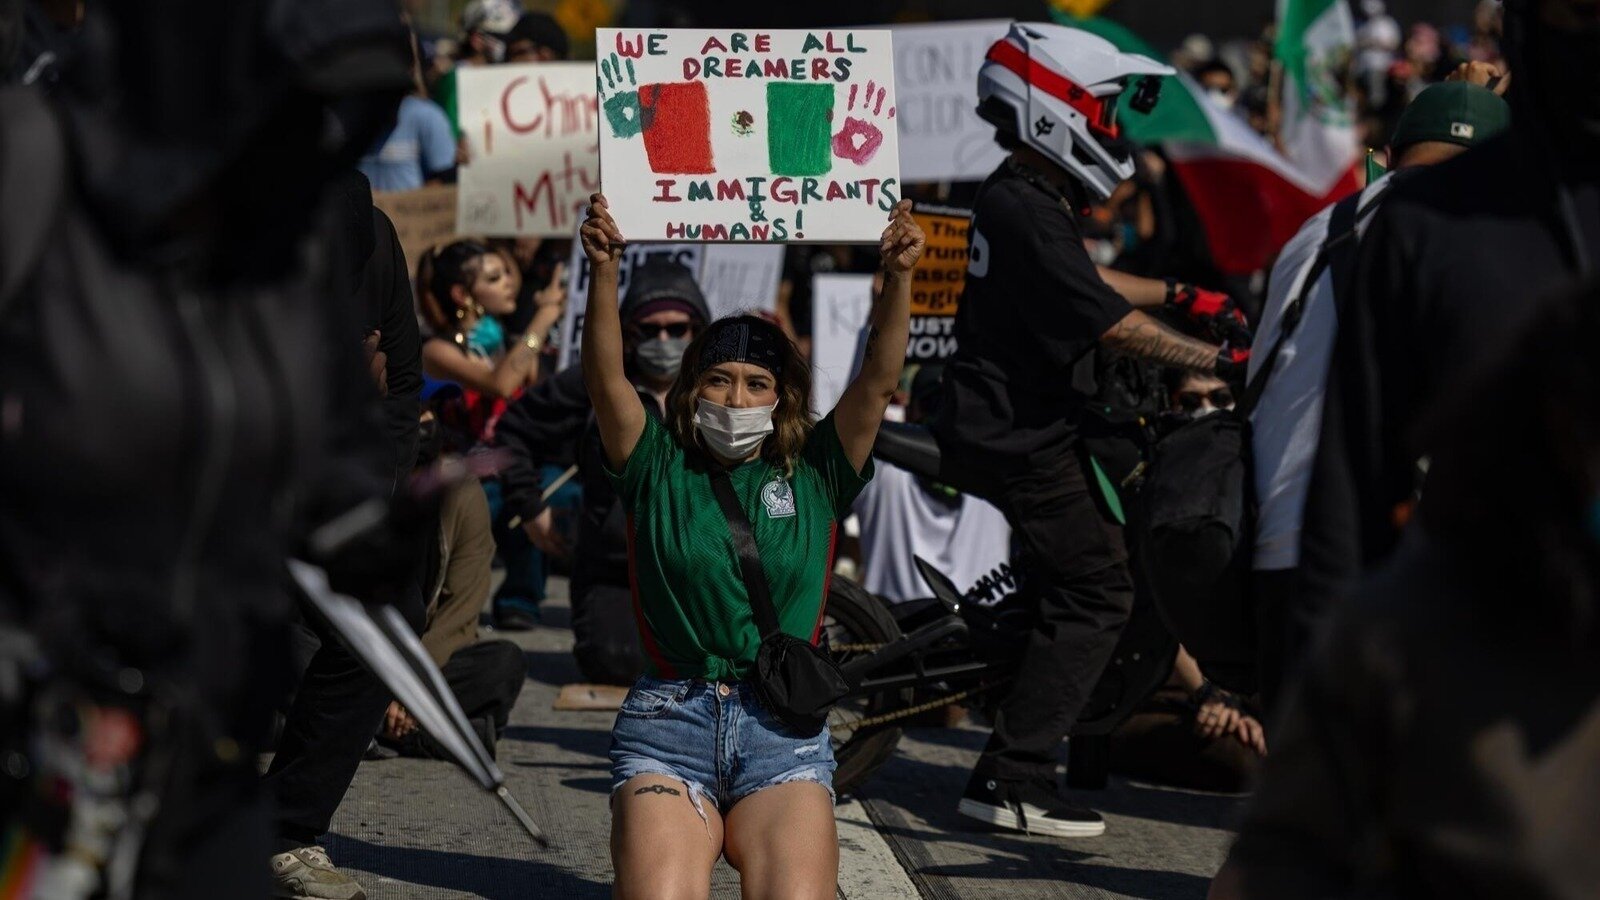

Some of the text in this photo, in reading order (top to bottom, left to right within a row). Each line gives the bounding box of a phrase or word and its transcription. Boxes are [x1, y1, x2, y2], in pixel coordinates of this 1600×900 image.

[616, 31, 868, 59] WE ARE ALL
[683, 57, 853, 82] DREAMERS
[653, 176, 897, 212] IMMIGRANTS
[749, 201, 769, 222] &
[666, 210, 805, 241] HUMANS!
[909, 317, 955, 336] UST
